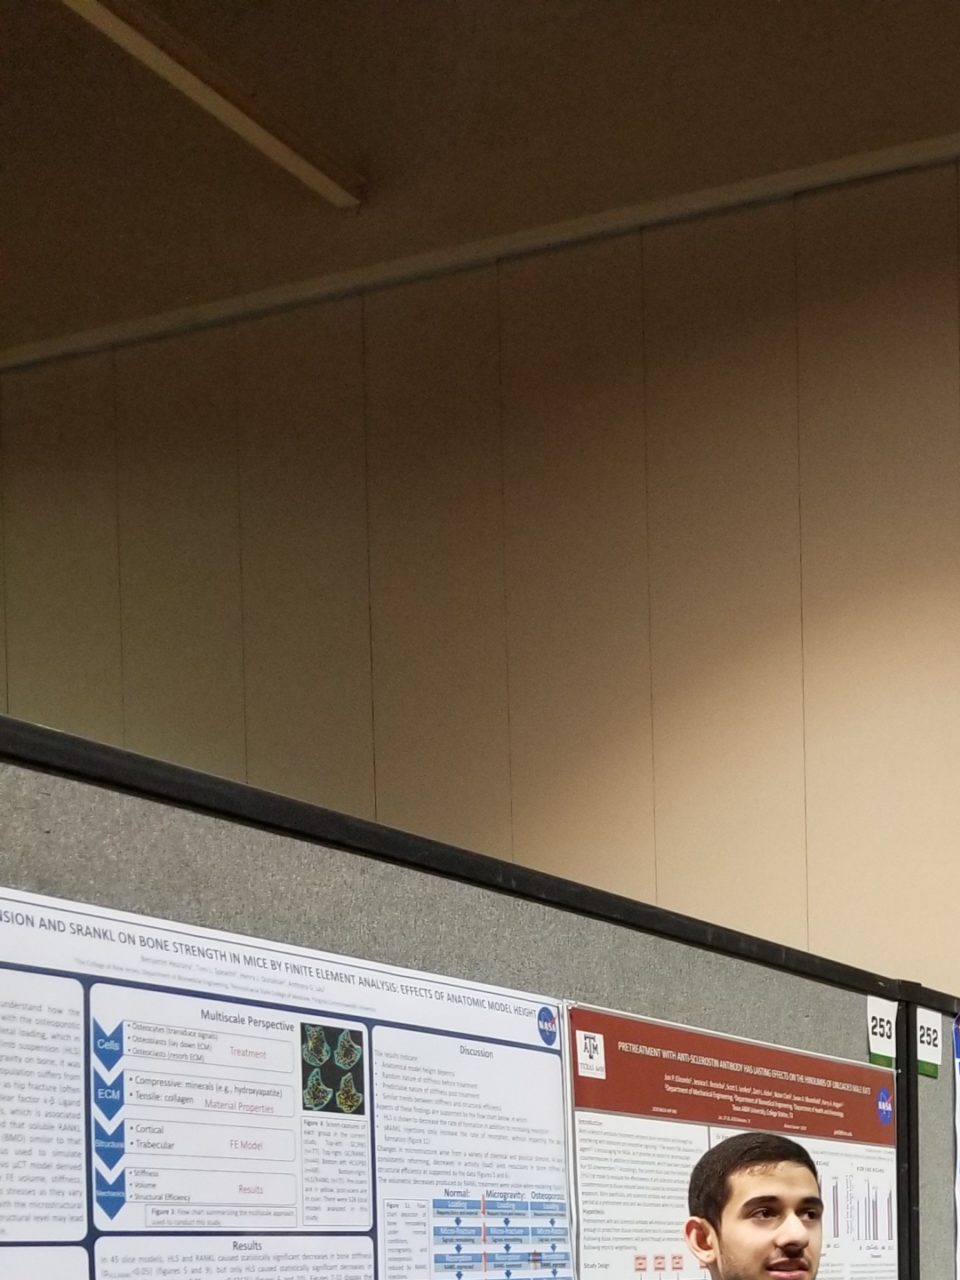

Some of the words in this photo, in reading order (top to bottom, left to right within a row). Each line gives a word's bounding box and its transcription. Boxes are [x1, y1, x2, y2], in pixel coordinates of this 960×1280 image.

[0, 910, 35, 928] SION
[38, 917, 67, 933] AND
[70, 922, 116, 942] SRANKL
[118, 931, 137, 946] ON
[139, 935, 170, 951] BONE
[173, 941, 227, 962] STRENGTH
[229, 951, 241, 965] IN
[243, 955, 269, 969] MICE
[271, 959, 283, 971] BY
[285, 962, 314, 978] FINITE
[315, 967, 356, 985] ELEMENT
[358, 975, 400, 993] ANALYSIS:
[400, 985, 433, 1000] EFFECTS
[434, 990, 446, 1001] OF
[447, 993, 487, 1010] ANATOMIC
[488, 1001, 513, 1014] MODEL
[514, 1006, 537, 1018] HEIGHT
[200, 1009, 246, 1026] Multiscale
[248, 1016, 295, 1033] Perspective
[871, 1016, 893, 1040] 253
[919, 1025, 939, 1048] 252
[97, 1039, 120, 1051] Cells
[229, 1046, 267, 1059] Treatment
[459, 1044, 494, 1060] Discussion
[617, 1041, 661, 1059] PRETREATMENT
[662, 1050, 676, 1060] WITH
[677, 1052, 720, 1068] ANTI-SCLEROSTIN
[720, 1060, 743, 1073] ANTIBODY
[753, 1066, 772, 1078] LASTING
[772, 1069, 790, 1081] EFFECTS
[135, 1076, 183, 1089] Compressive:
[185, 1081, 214, 1091] minerals
[97, 1088, 120, 1100] ECM
[136, 1090, 163, 1101] Tensile:
[164, 1094, 194, 1104] collagen
[205, 1099, 237, 1111] Material
[238, 1102, 274, 1114] Properties
[878, 1101, 892, 1112] NASA
[135, 1124, 164, 1134] Cortical
[136, 1140, 175, 1150] Trabecular
[230, 1139, 239, 1149] FE
[240, 1140, 263, 1151] Model
[238, 1184, 264, 1195] Results
[444, 1188, 471, 1198] Normal:
[134, 1193, 162, 1201] Structural
[164, 1194, 191, 1203] Efficiency
[232, 1240, 263, 1251] Results
